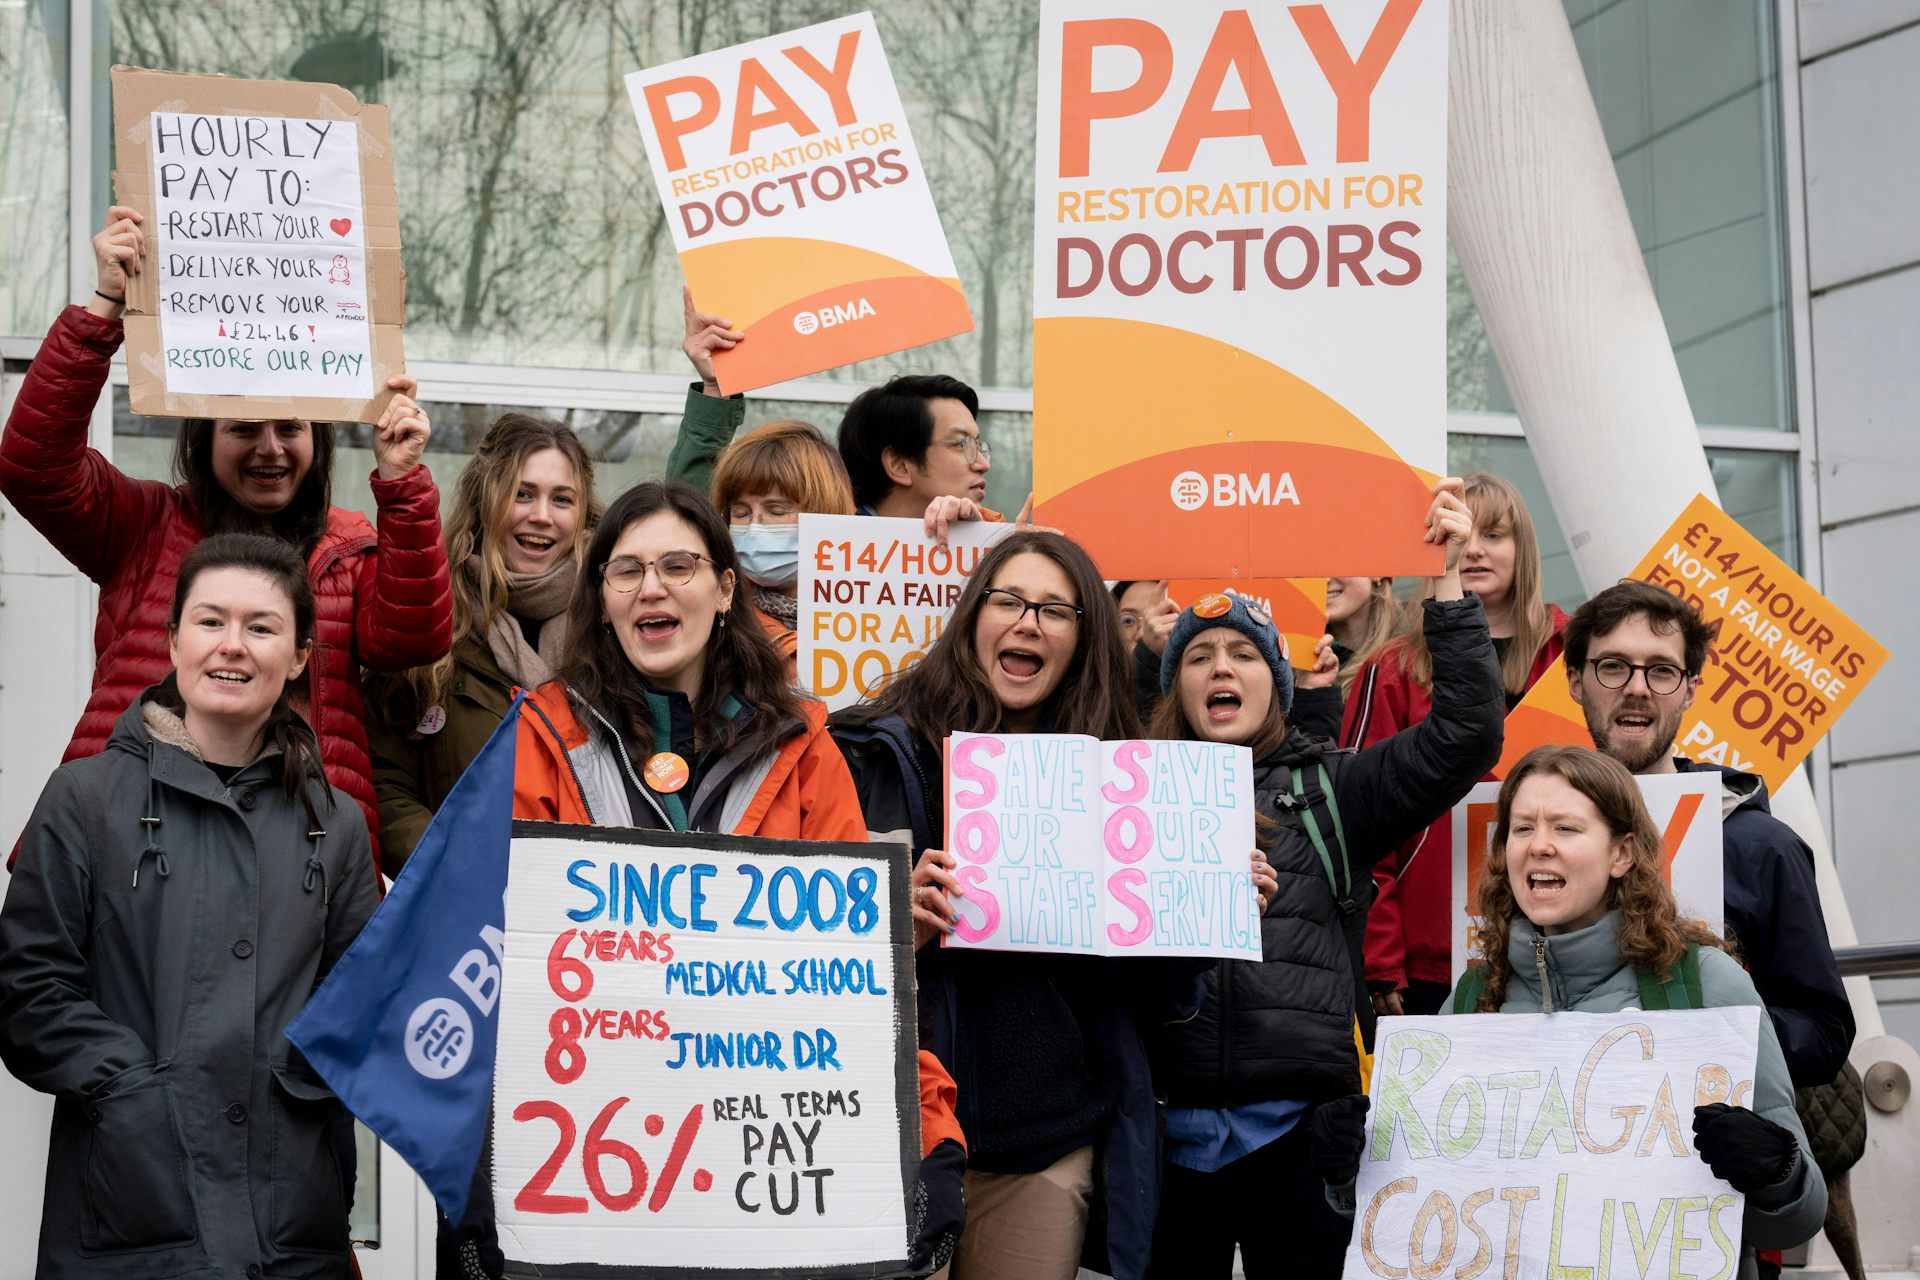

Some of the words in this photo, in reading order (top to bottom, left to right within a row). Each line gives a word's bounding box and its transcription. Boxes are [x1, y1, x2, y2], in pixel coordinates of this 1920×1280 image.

[643, 30, 862, 173] PAY
[1059, 0, 1424, 178] PAY
[156, 115, 332, 159] HOURLY
[671, 136, 843, 197] RESTORATION
[846, 122, 897, 152] FOR
[161, 163, 238, 202] PAY
[256, 169, 310, 206] TO:
[678, 149, 909, 239] DOCTORS
[1057, 178, 1331, 223] RESTORATION
[1343, 173, 1424, 210] FOR
[272, 214, 324, 240] YOUR
[265, 256, 322, 279] YOUR
[1057, 220, 1423, 299] DOCTORS
[277, 295, 328, 314] YOUR
[818, 298, 876, 329] BMA
[166, 347, 254, 371] RESTORE
[267, 350, 312, 372] OUR
[322, 351, 363, 376] PAY
[1213, 471, 1301, 507] BMA
[814, 539, 992, 577] £14/HOU
[814, 579, 871, 605] NOT
[877, 582, 896, 606] A
[904, 583, 962, 608] FAIR
[1664, 543, 1716, 589] NOT
[1709, 585, 1731, 609] A
[1729, 598, 1784, 650] FAIR
[1782, 639, 1846, 702] WAGE
[1683, 522, 1835, 655] £14/HOUR
[1830, 644, 1865, 679] IS
[813, 611, 881, 643] FOR
[890, 614, 915, 644] A
[1719, 633, 1827, 725] JUNIOR
[952, 737, 1086, 812] SAVE
[1101, 741, 1235, 808] SAVE
[954, 810, 1062, 868] OUR
[1104, 806, 1222, 864] OUR
[566, 859, 718, 932] SINCE
[733, 864, 879, 935] 2008
[953, 865, 1096, 947] STAFF
[547, 928, 594, 1002] 6
[581, 930, 674, 964] YEARS
[665, 959, 776, 996] MEDICAL
[781, 958, 887, 996] SCHOOL
[545, 1007, 587, 1084] 8
[582, 1008, 670, 1040] YEARS
[666, 1031, 787, 1071] JUNIOR
[793, 1027, 842, 1072] DR
[713, 1095, 768, 1121] REAL
[781, 1090, 861, 1118] TERMS
[513, 1096, 714, 1214] 26%
[743, 1119, 821, 1166] PAY
[735, 1168, 834, 1216] CUT
[1361, 1176, 1540, 1280] COST
[1548, 1173, 1737, 1280] LIVES
